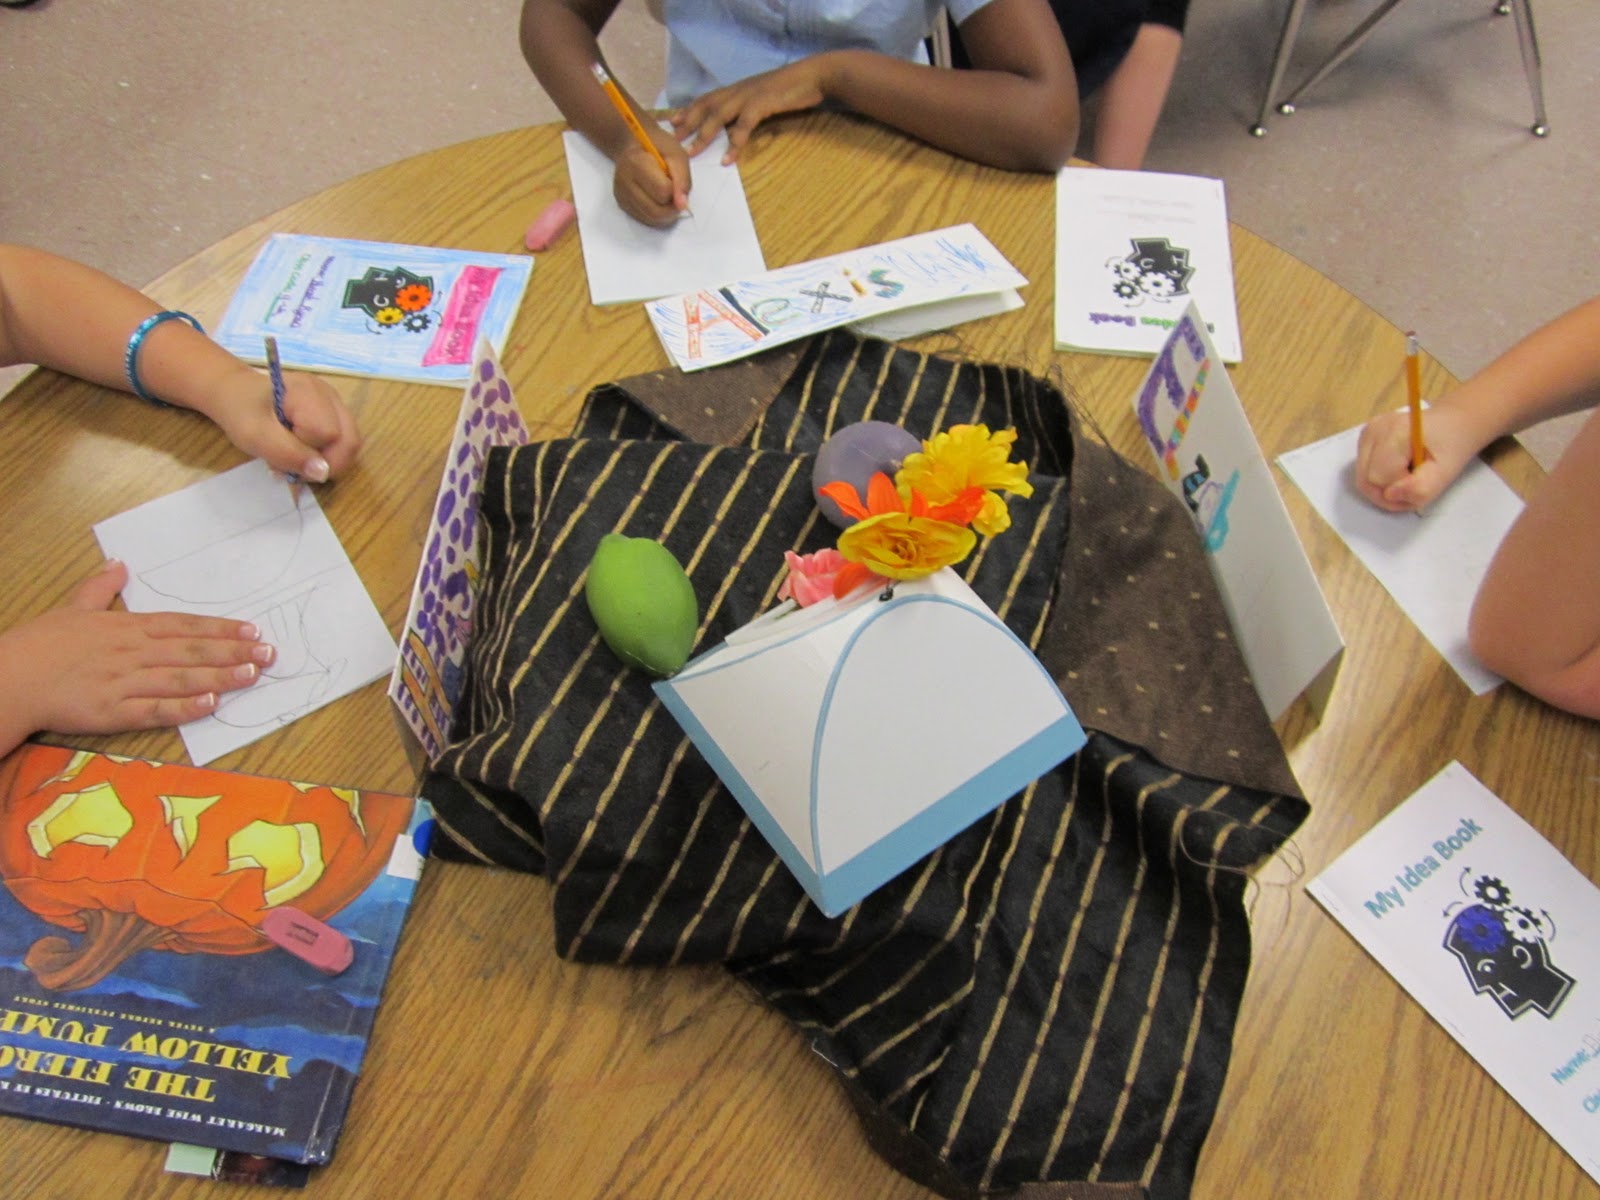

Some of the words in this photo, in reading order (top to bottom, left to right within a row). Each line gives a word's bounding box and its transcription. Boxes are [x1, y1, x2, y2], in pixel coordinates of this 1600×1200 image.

[1363, 885, 1405, 920] My
[1394, 855, 1441, 892] Idea
[1432, 817, 1483, 861] Book
[118, 1031, 293, 1079] YELLOW
[1551, 1048, 1589, 1085] Name:
[13, 1083, 32, 1094] BY
[35, 1086, 102, 1105] PICTURES
[123, 1066, 217, 1103] THE
[113, 1100, 163, 1117] BROWN
[165, 1108, 202, 1123] WISE
[205, 1115, 288, 1137] MARGARET
